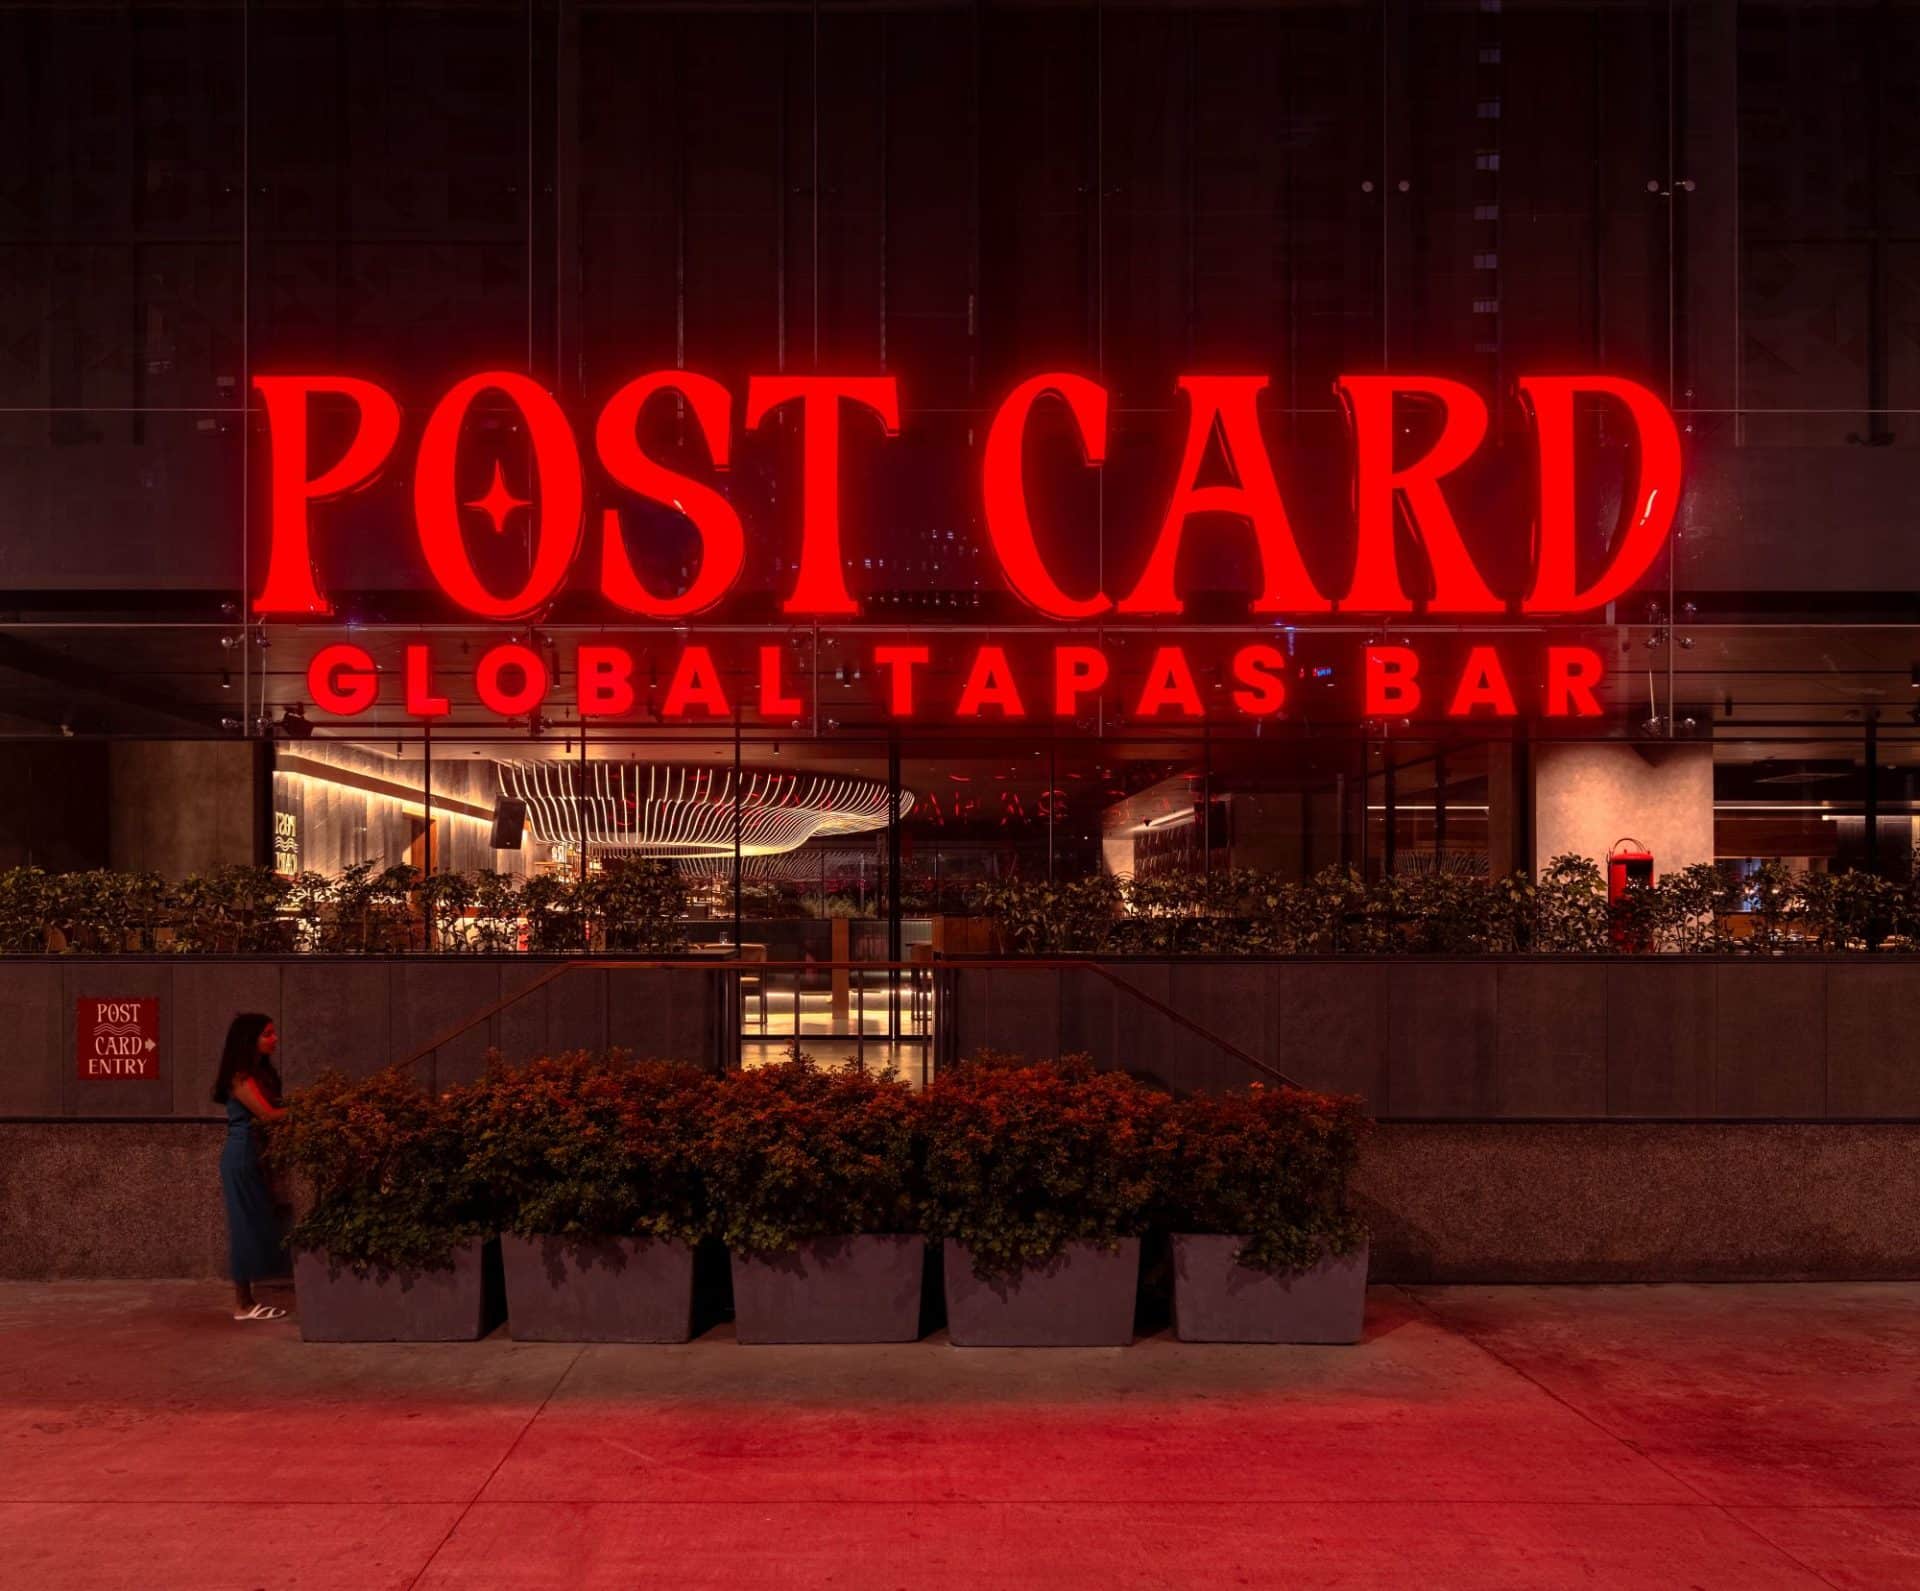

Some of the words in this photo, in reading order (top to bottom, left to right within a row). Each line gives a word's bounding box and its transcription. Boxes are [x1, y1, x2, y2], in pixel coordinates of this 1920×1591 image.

[253, 371, 900, 616] POST
[983, 372, 1682, 617] CARD
[308, 645, 801, 716] GLOBAL
[874, 646, 1285, 716] TAPAS
[1366, 646, 1603, 716] BAR
[97, 1003, 141, 1023] POST
[95, 1036, 142, 1056] CARD
[88, 1058, 147, 1075] ENTRY
